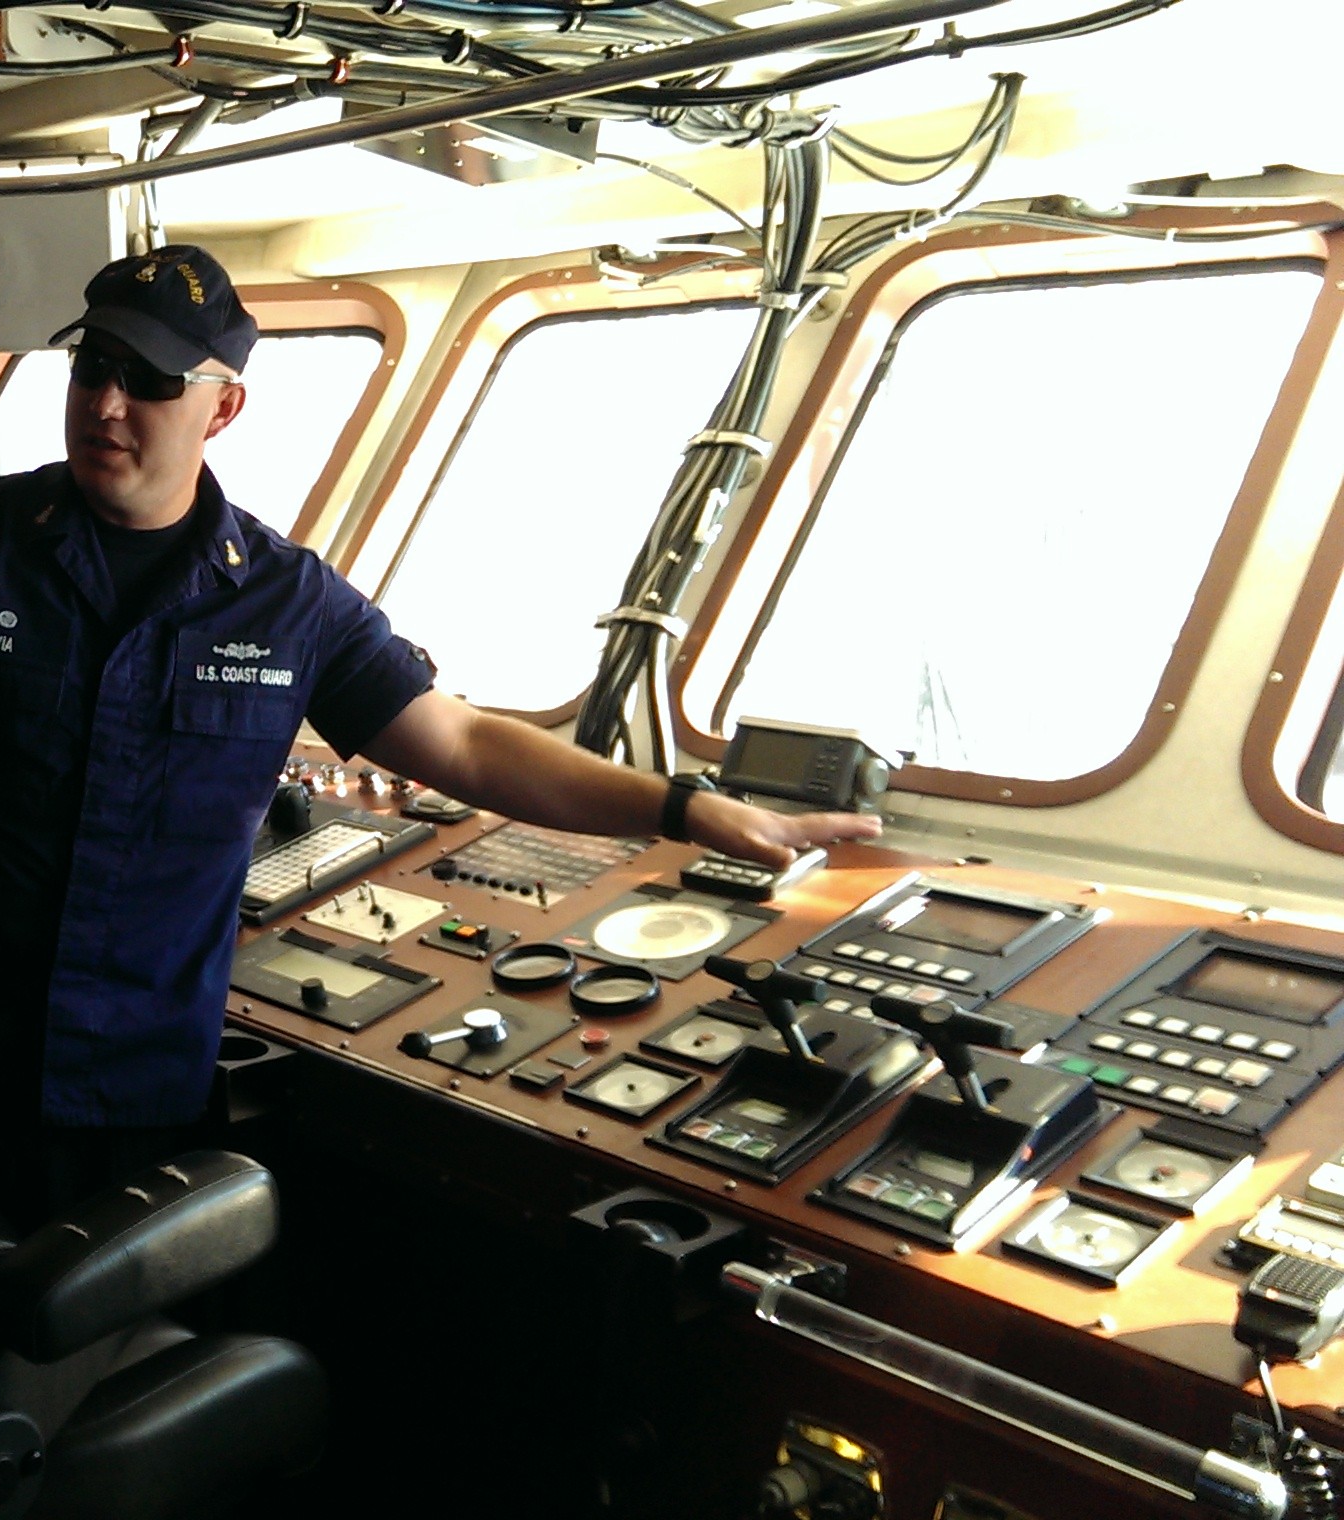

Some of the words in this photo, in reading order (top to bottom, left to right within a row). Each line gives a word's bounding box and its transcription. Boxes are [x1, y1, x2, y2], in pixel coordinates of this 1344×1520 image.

[176, 262, 205, 305] GUARD
[196, 664, 220, 682] U.S.
[221, 665, 258, 684] COAST
[259, 668, 293, 686] GUARD
